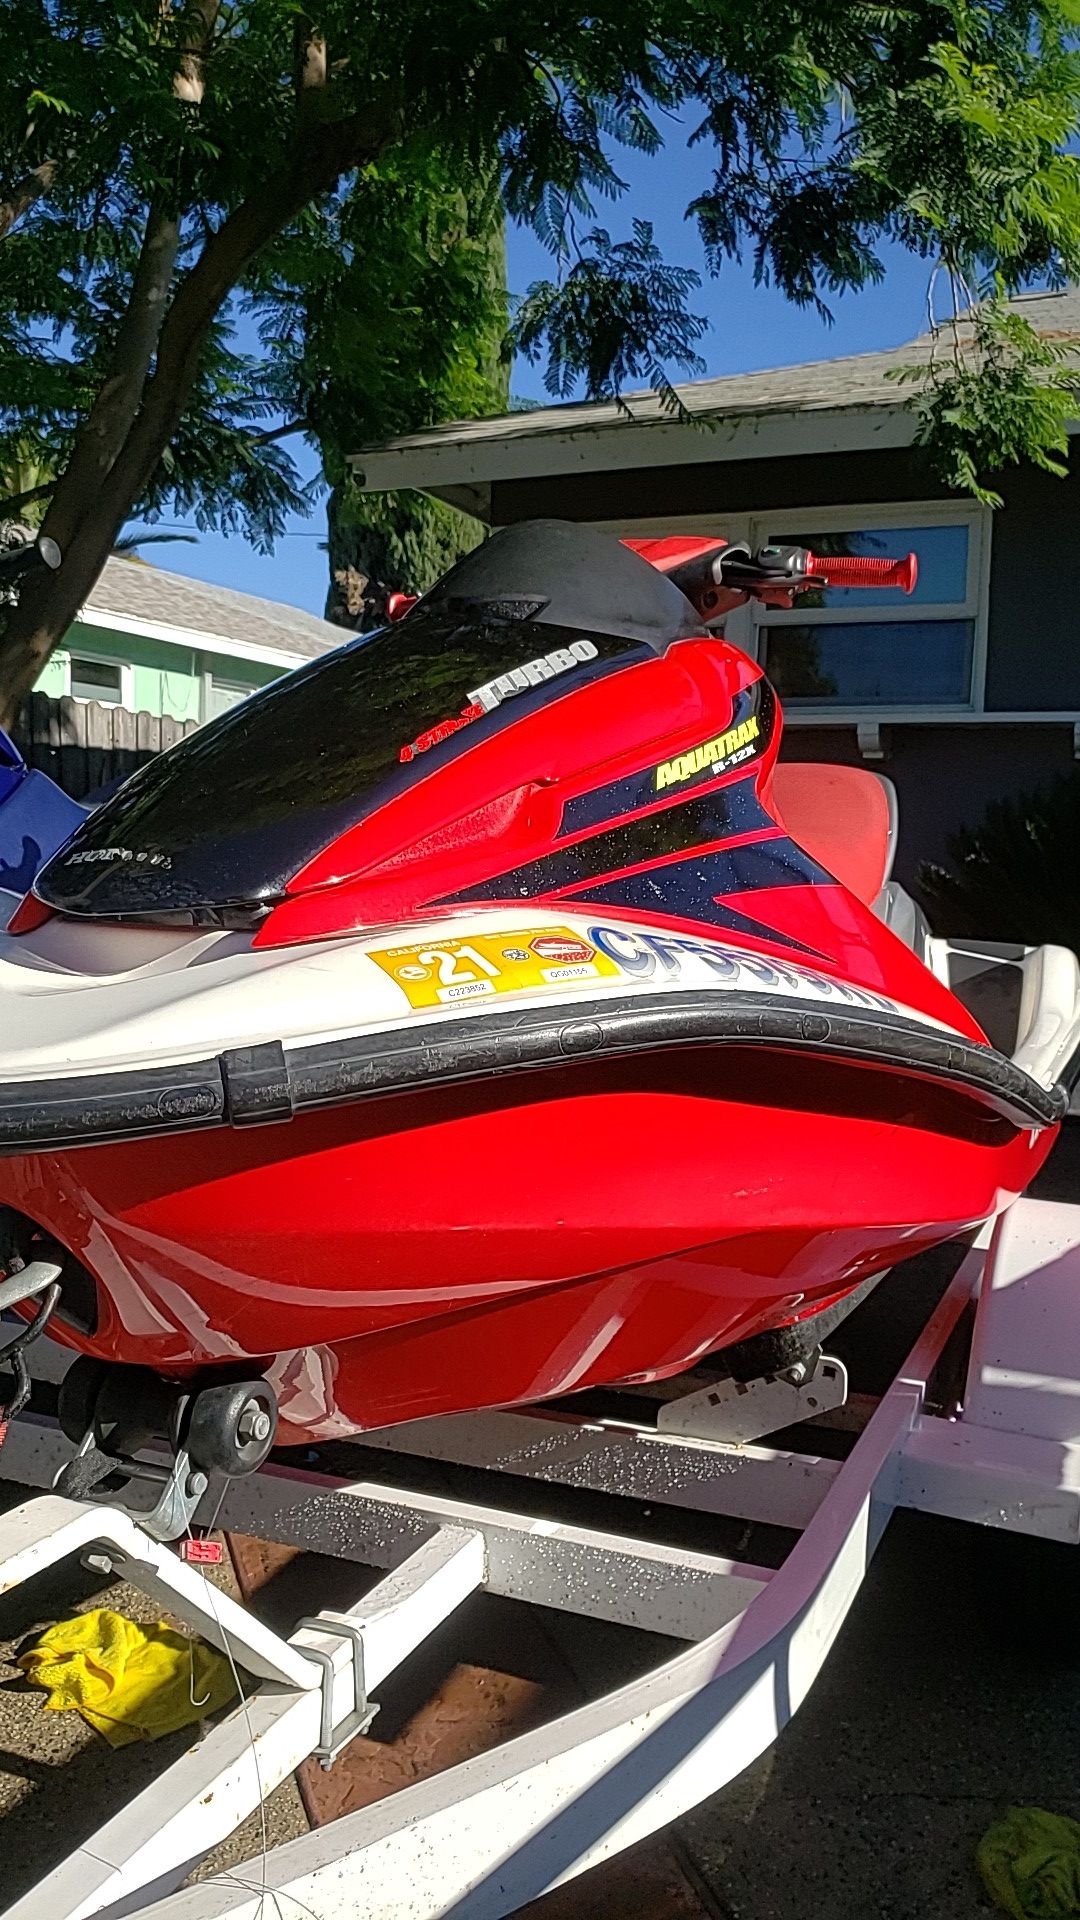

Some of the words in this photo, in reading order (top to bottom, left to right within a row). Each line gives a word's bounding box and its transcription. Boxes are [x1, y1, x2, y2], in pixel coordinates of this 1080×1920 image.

[467, 640, 599, 713] TURBO
[656, 716, 760, 791] AQUATRAX
[711, 744, 757, 775] R-12X
[387, 940, 461, 957] CALIFORNIA
[418, 945, 502, 986] 21
[448, 983, 487, 998] C223852
